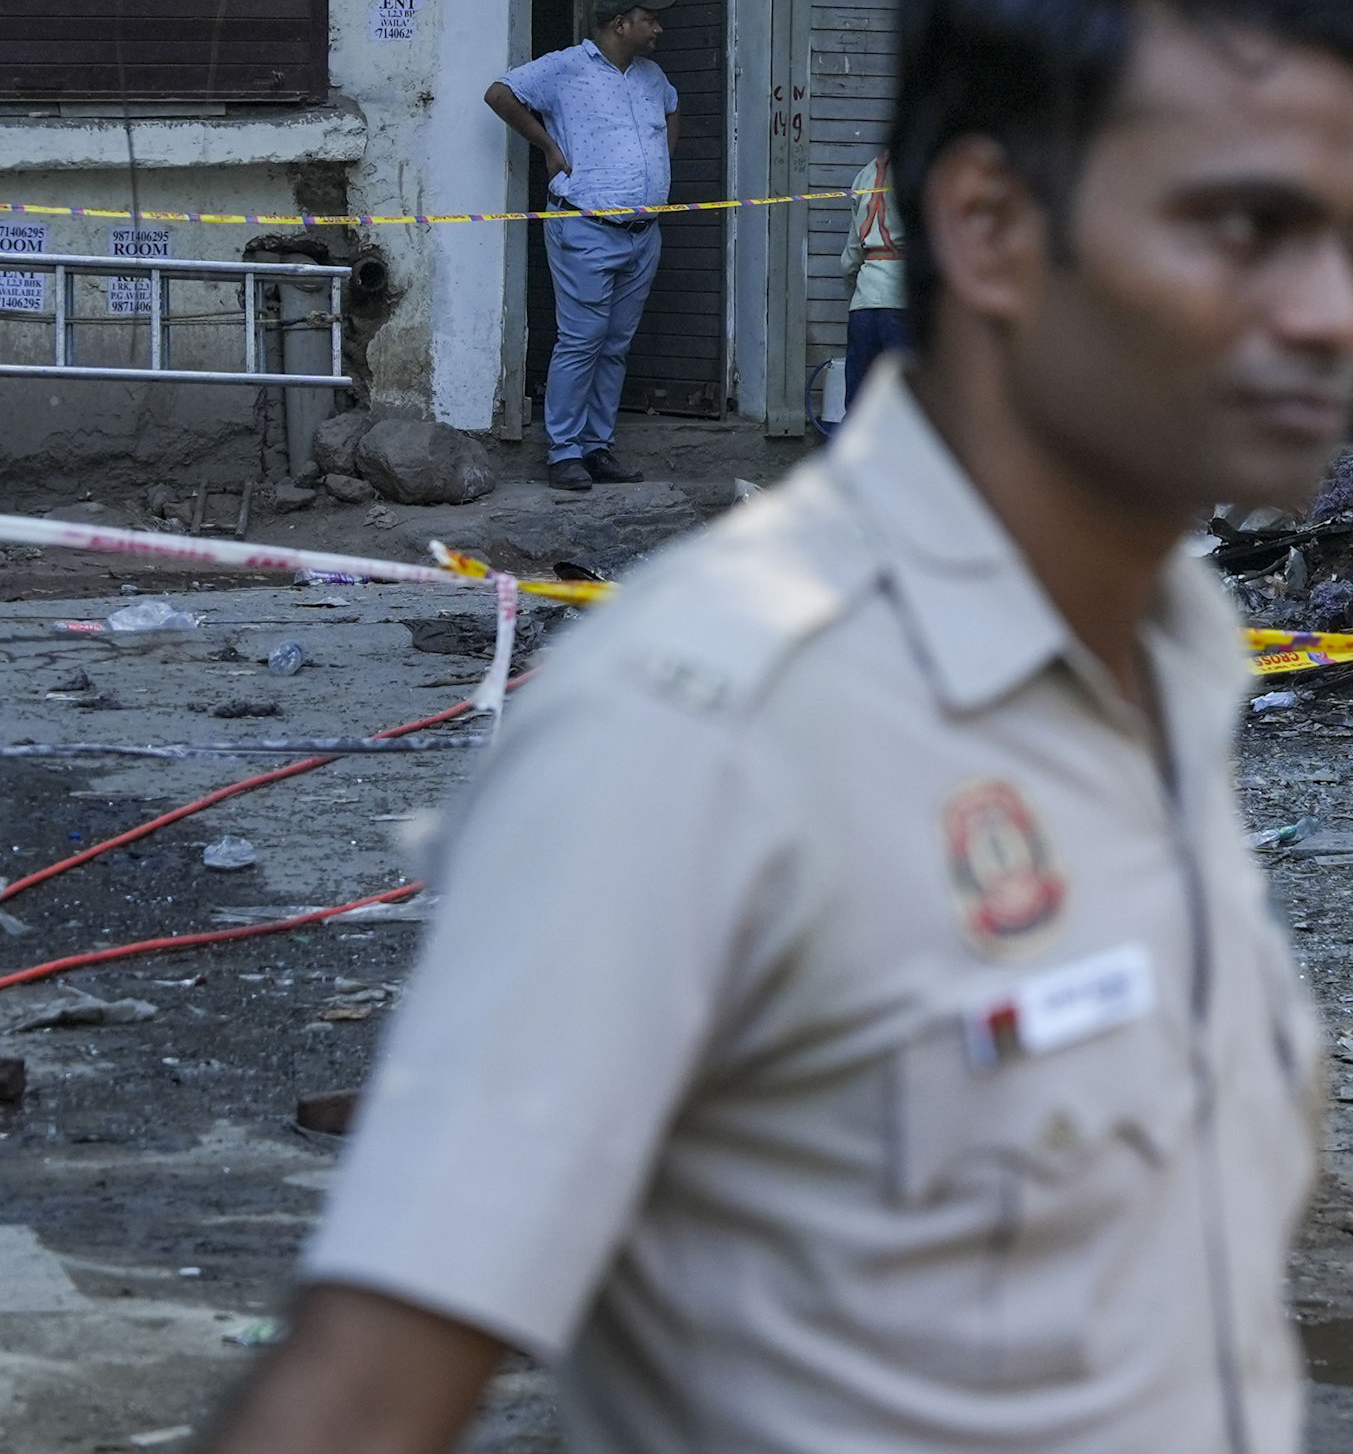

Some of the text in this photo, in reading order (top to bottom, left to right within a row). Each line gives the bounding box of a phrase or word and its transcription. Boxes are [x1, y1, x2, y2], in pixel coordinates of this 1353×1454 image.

[374, 28, 413, 39] 714062
[112, 230, 169, 242] 9871406295
[0, 238, 43, 252] OOM
[113, 243, 168, 255] ROOM
[24, 279, 42, 287] BHK
